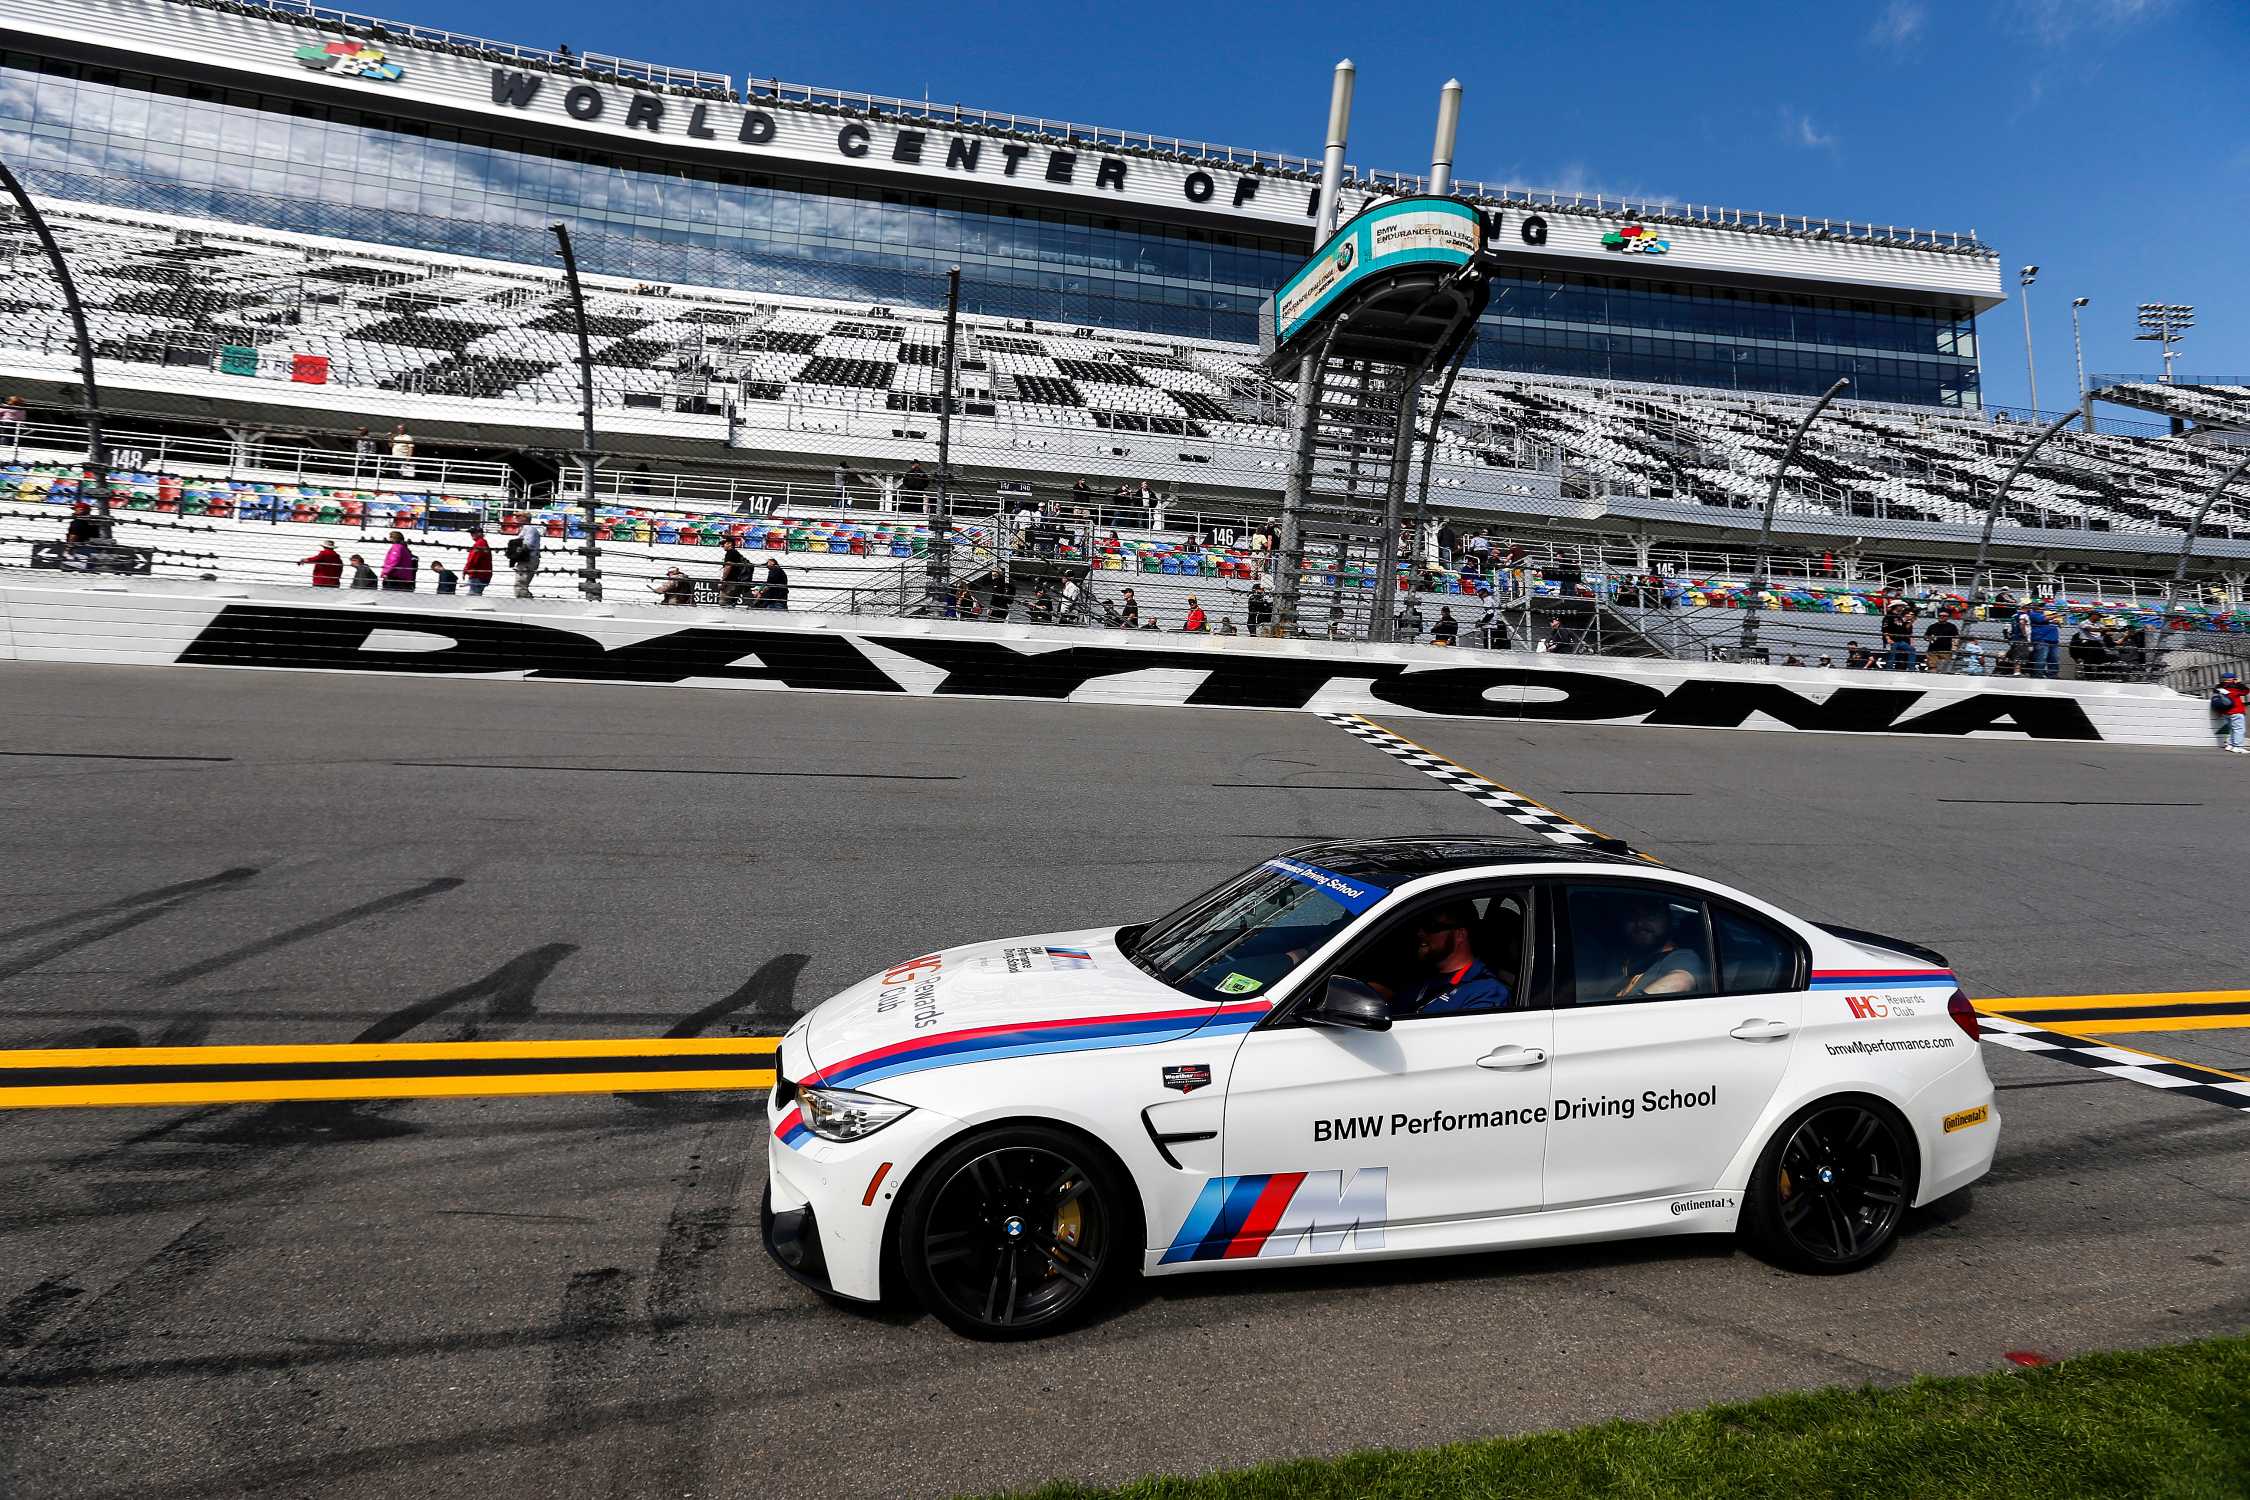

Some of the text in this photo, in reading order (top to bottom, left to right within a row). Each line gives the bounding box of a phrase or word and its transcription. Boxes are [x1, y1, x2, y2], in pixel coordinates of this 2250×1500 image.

[491, 67, 1260, 208] WORLD CENTER OF
[1376, 224, 1398, 237] BMW
[1376, 228, 1431, 244] ENDURANCE
[110, 449, 143, 469] 148
[748, 495, 773, 515] 147
[1212, 527, 1234, 546] 146
[1656, 562, 1675, 578] 145
[693, 590, 743, 605] SECTS
[694, 581, 713, 596] ALL
[2036, 584, 2054, 598] 144
[176, 603, 2104, 741] DAYTONA
[1300, 868, 1330, 885] Driving
[1326, 878, 1365, 899] School
[877, 986, 907, 1013] Club
[914, 976, 945, 1029] Rewards
[1844, 995, 1889, 1019] IHG
[1884, 993, 1926, 1006] Rewards
[1892, 1006, 1916, 1018] Club
[1825, 1037, 1955, 1057] bmwMperformance.com
[1313, 1085, 1717, 1142] BMW Performance Driving School
[1943, 1109, 1981, 1133] Continental
[1670, 1198, 1724, 1216] Continental
